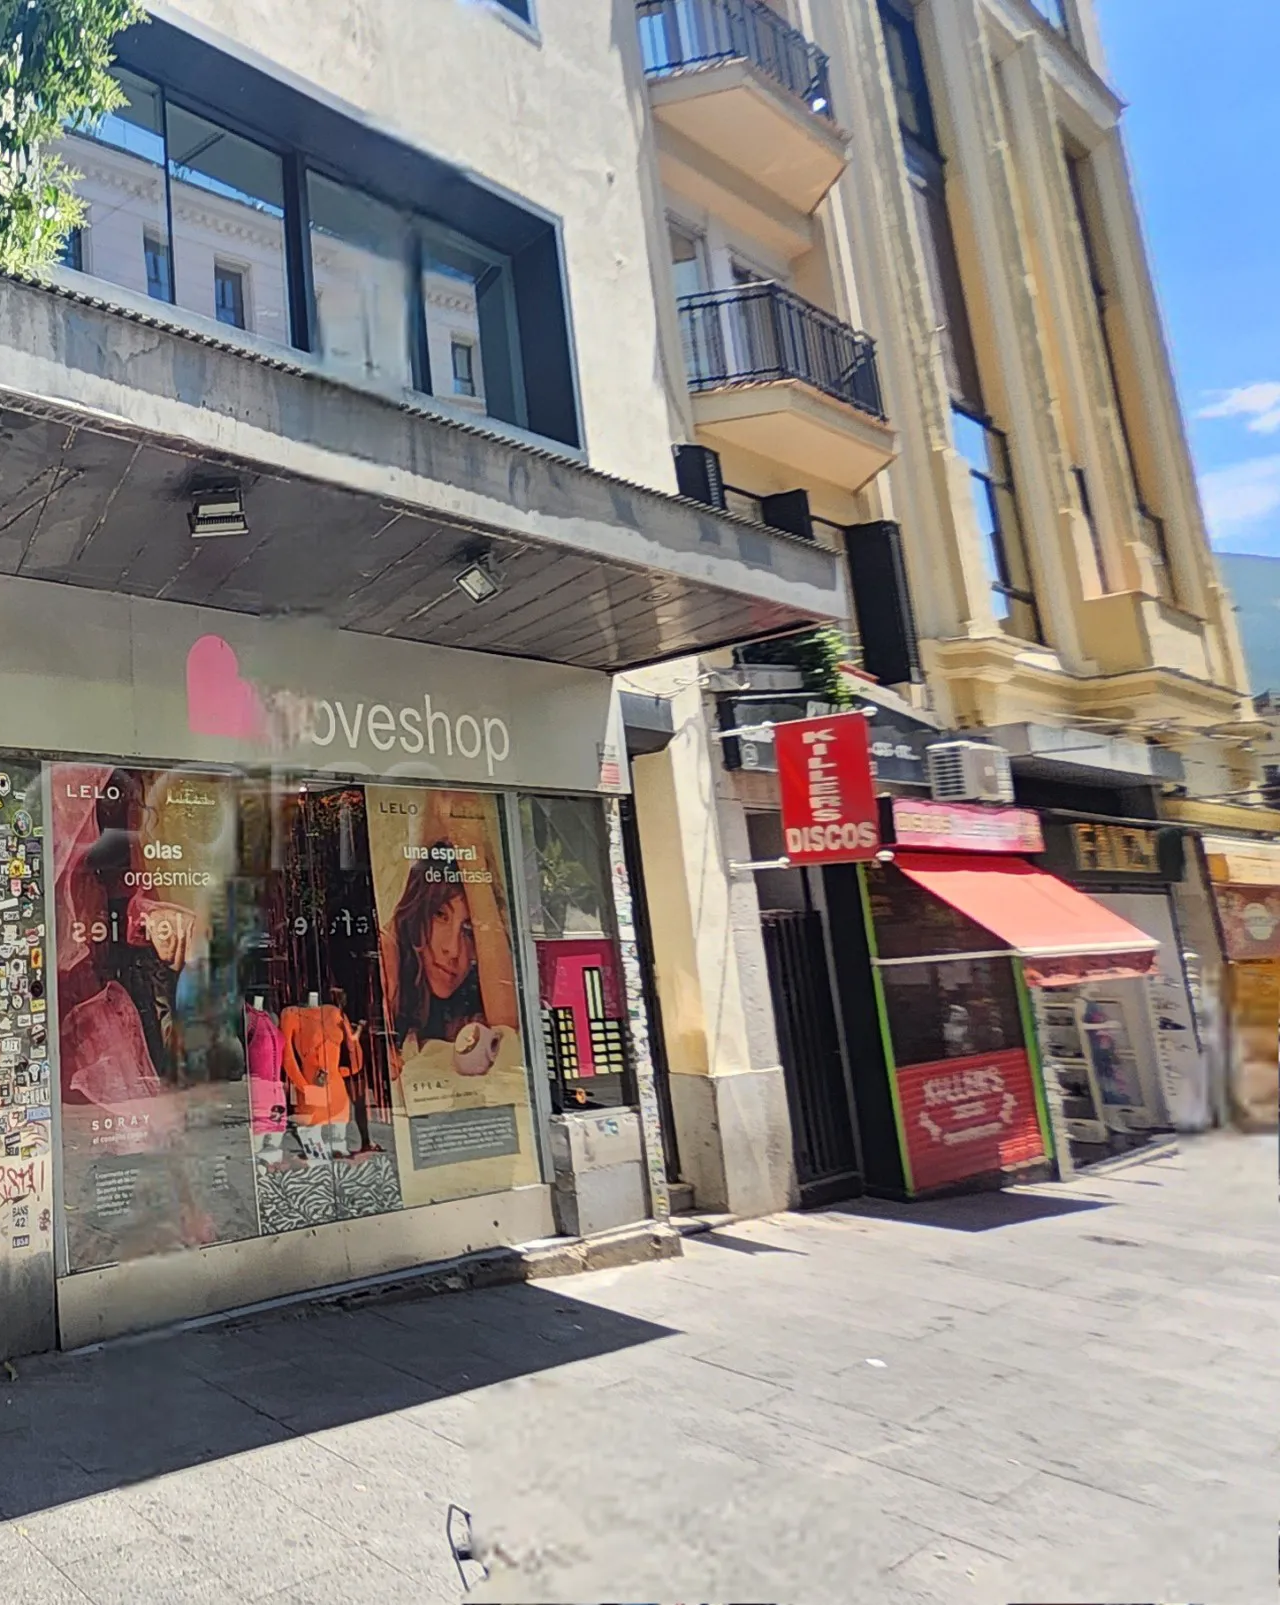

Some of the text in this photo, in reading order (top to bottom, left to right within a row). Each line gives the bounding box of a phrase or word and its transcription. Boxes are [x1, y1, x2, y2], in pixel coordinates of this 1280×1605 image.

[801, 728, 842, 823] KILLERS
[65, 784, 120, 800] LELO
[379, 802, 419, 815] LELO
[784, 821, 878, 853] DISCOS
[143, 841, 183, 860] olas
[403, 844, 477, 863] una espiral
[425, 866, 441, 883] de
